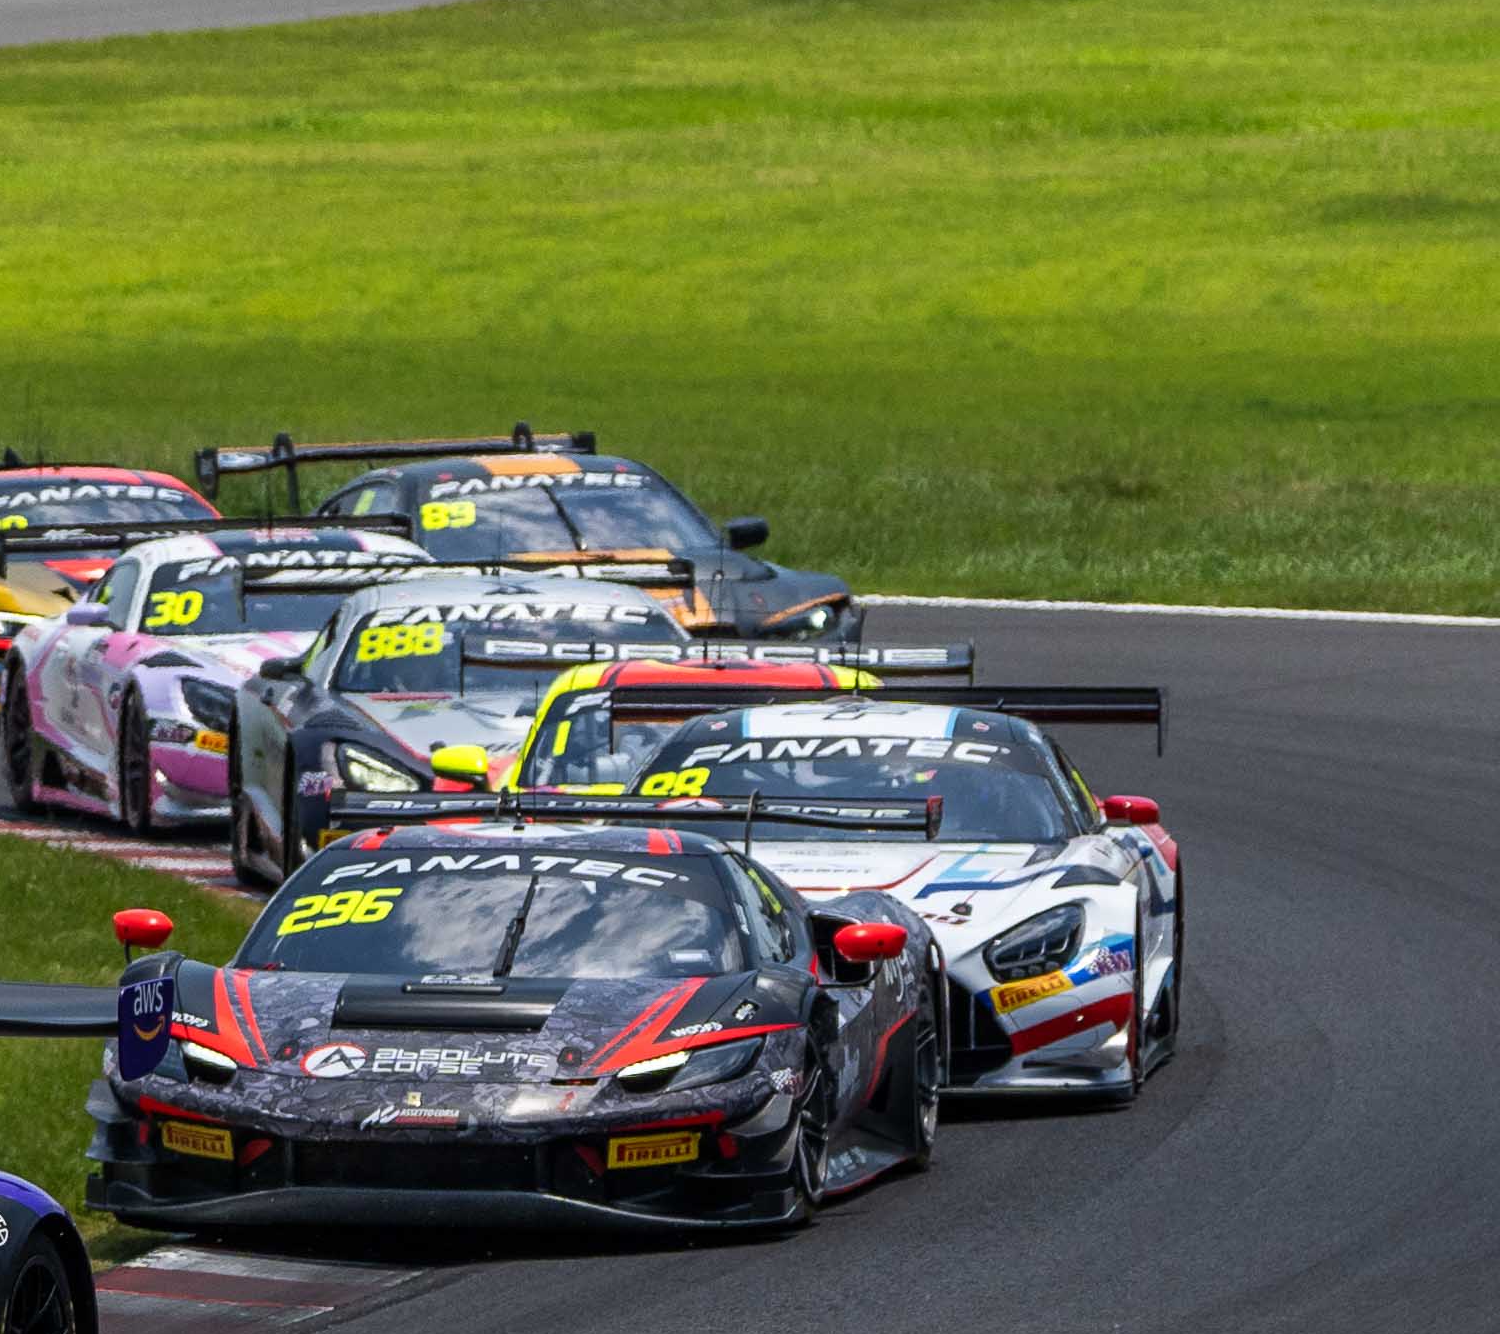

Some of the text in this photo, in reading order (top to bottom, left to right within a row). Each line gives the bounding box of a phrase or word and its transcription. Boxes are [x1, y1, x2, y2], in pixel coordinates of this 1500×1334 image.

[430, 473, 644, 500] FANATEC
[419, 501, 477, 532] 89
[178, 549, 418, 582] FANATEC
[145, 590, 204, 628] 30
[367, 602, 650, 628] FANATEC
[355, 621, 445, 664] 888
[484, 639, 949, 666] PORSCHE
[680, 738, 1000, 768] FANATEC
[320, 854, 679, 888] FANATEC
[276, 887, 404, 938] 296
[133, 982, 165, 1016] aws
[998, 974, 1066, 1009] PIRELLI
[167, 1124, 226, 1155] PIRELLI
[616, 1137, 692, 1164] PIRELLI
